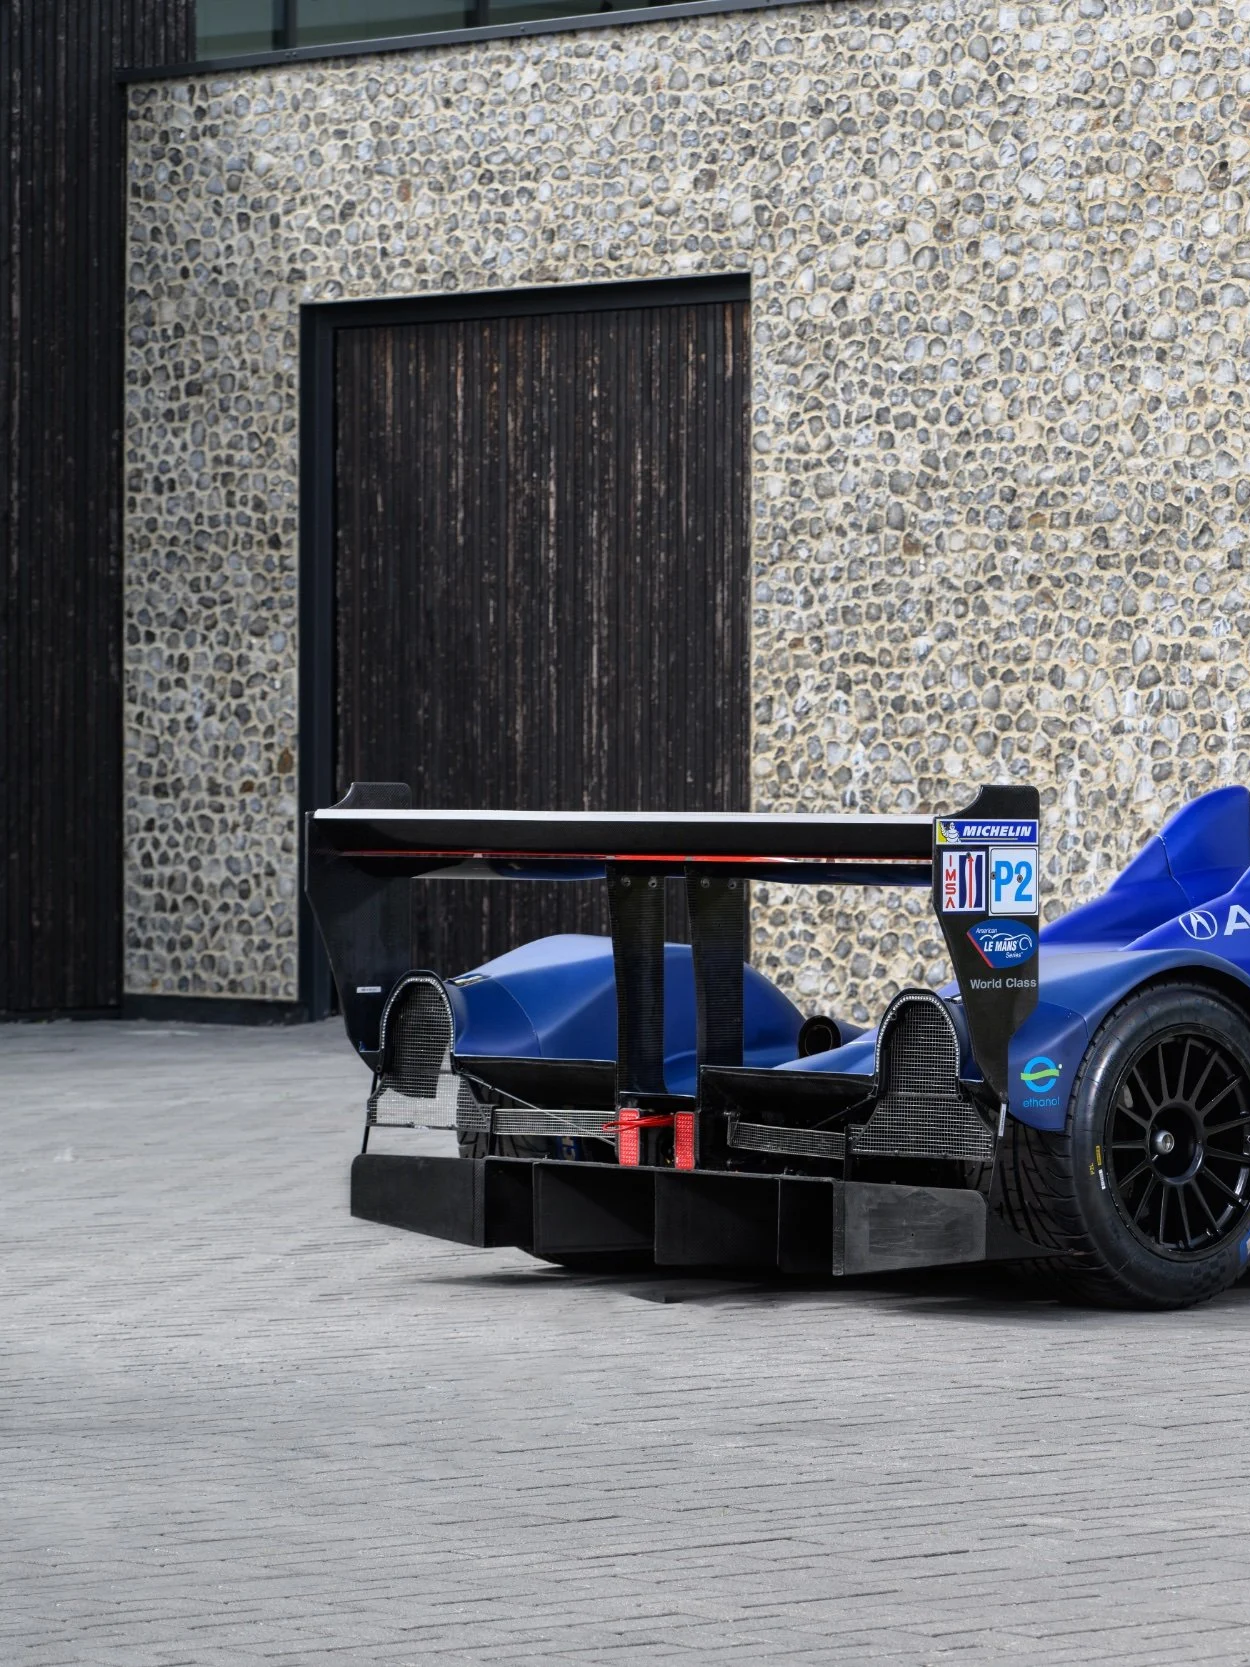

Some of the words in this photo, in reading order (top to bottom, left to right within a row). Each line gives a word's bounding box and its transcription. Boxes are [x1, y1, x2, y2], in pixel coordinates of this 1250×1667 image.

[962, 825, 1032, 837] MICHELIN
[945, 854, 957, 909] IMSA
[994, 860, 1033, 902] P2
[983, 940, 994, 952] LE
[994, 940, 1018, 952] MANS
[970, 978, 1002, 989] World
[1005, 977, 1037, 988] Class
[1023, 1096, 1060, 1108] ethanol
